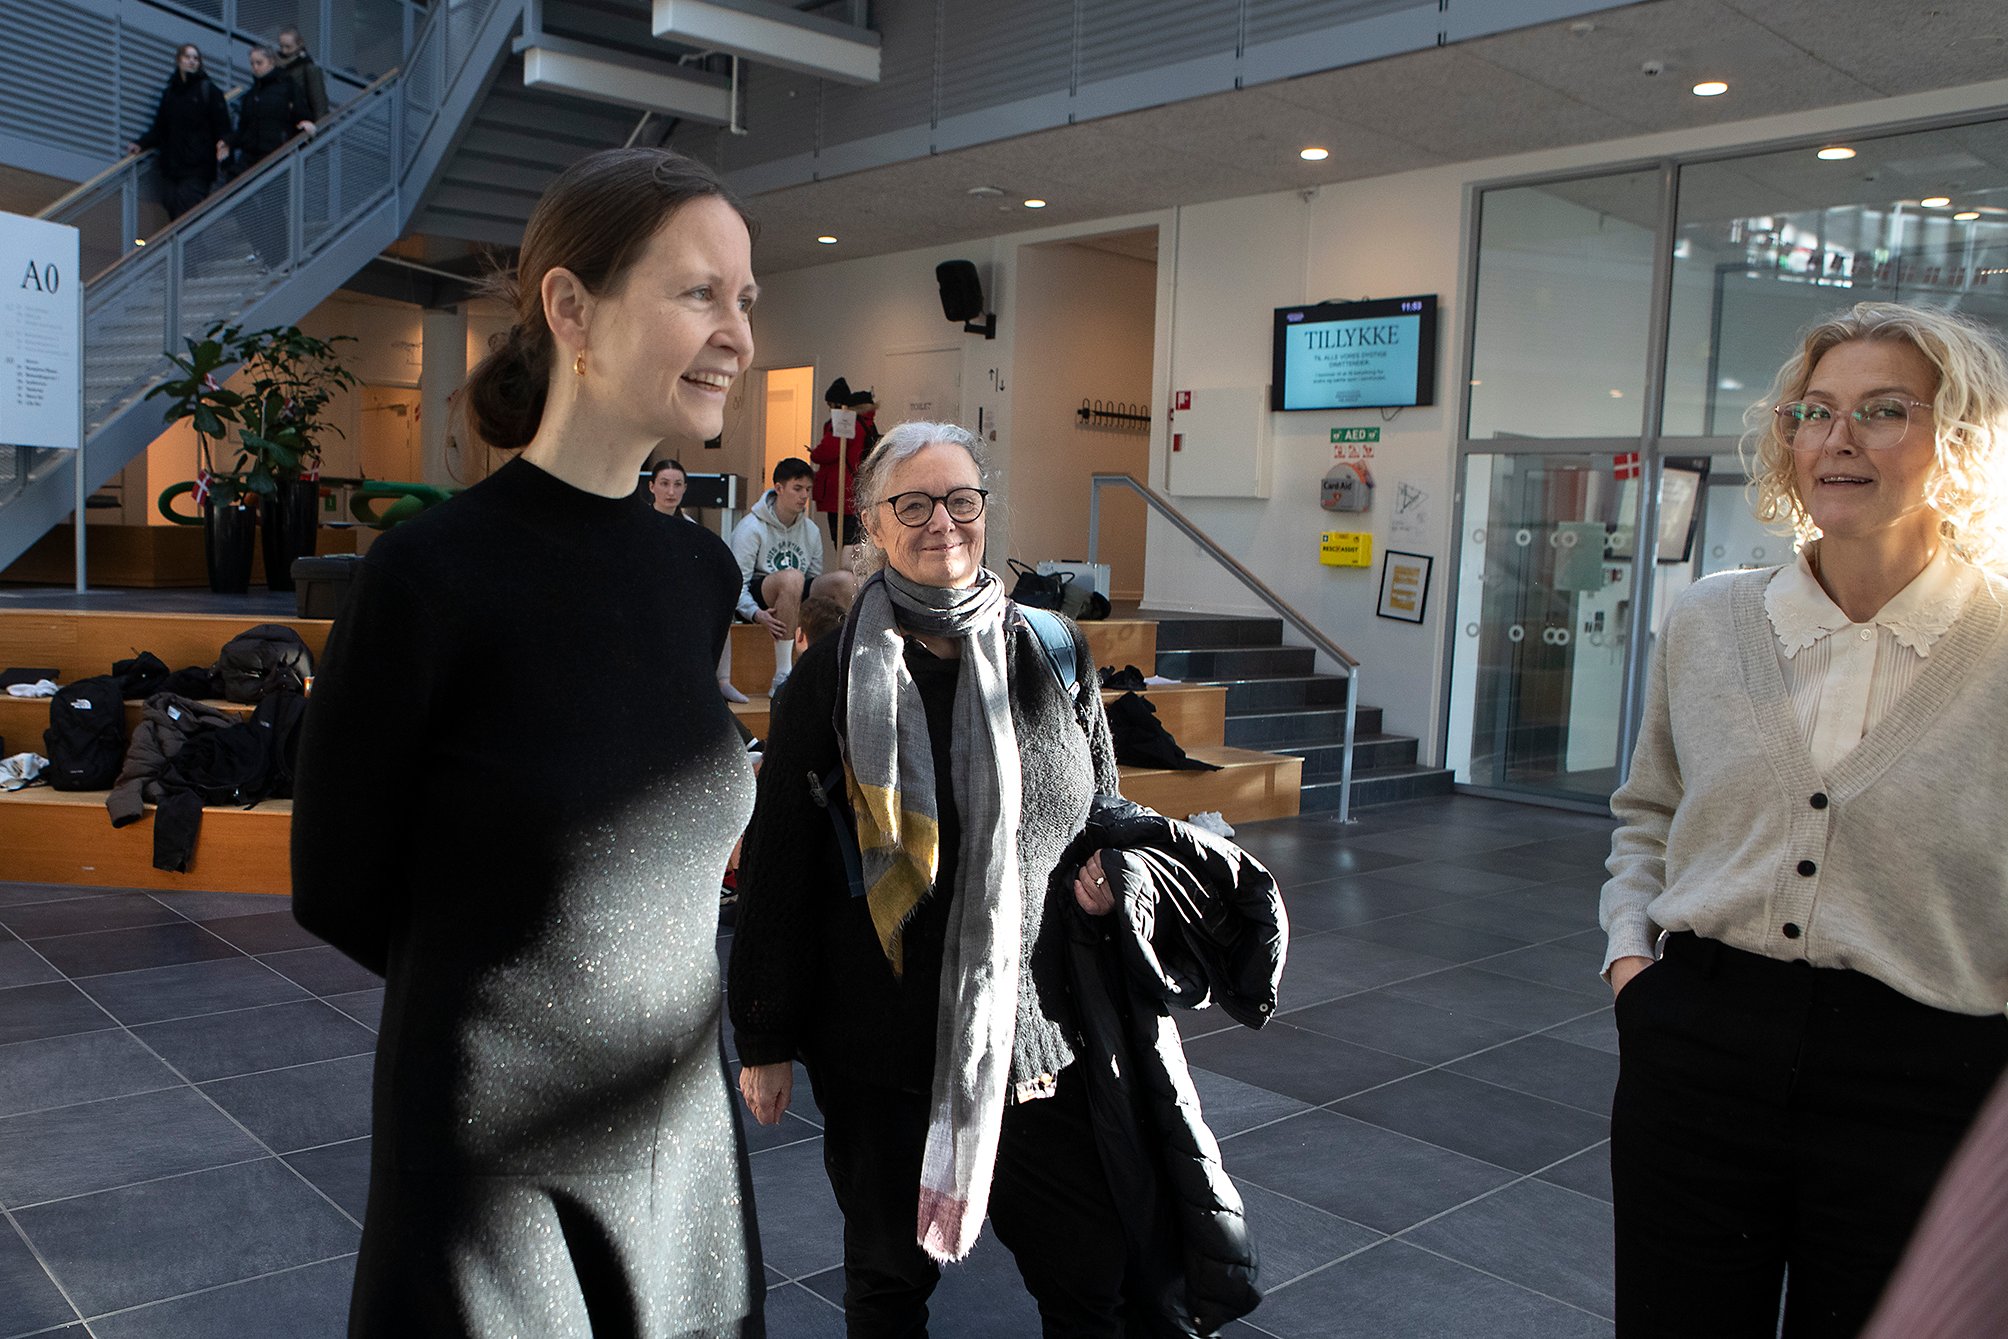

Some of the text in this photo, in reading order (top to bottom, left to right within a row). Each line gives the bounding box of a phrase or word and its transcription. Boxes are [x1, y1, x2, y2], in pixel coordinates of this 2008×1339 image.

[21, 260, 59, 295] A0
[1305, 325, 1399, 350] TILLYKKE
[1344, 429, 1366, 440] AED
